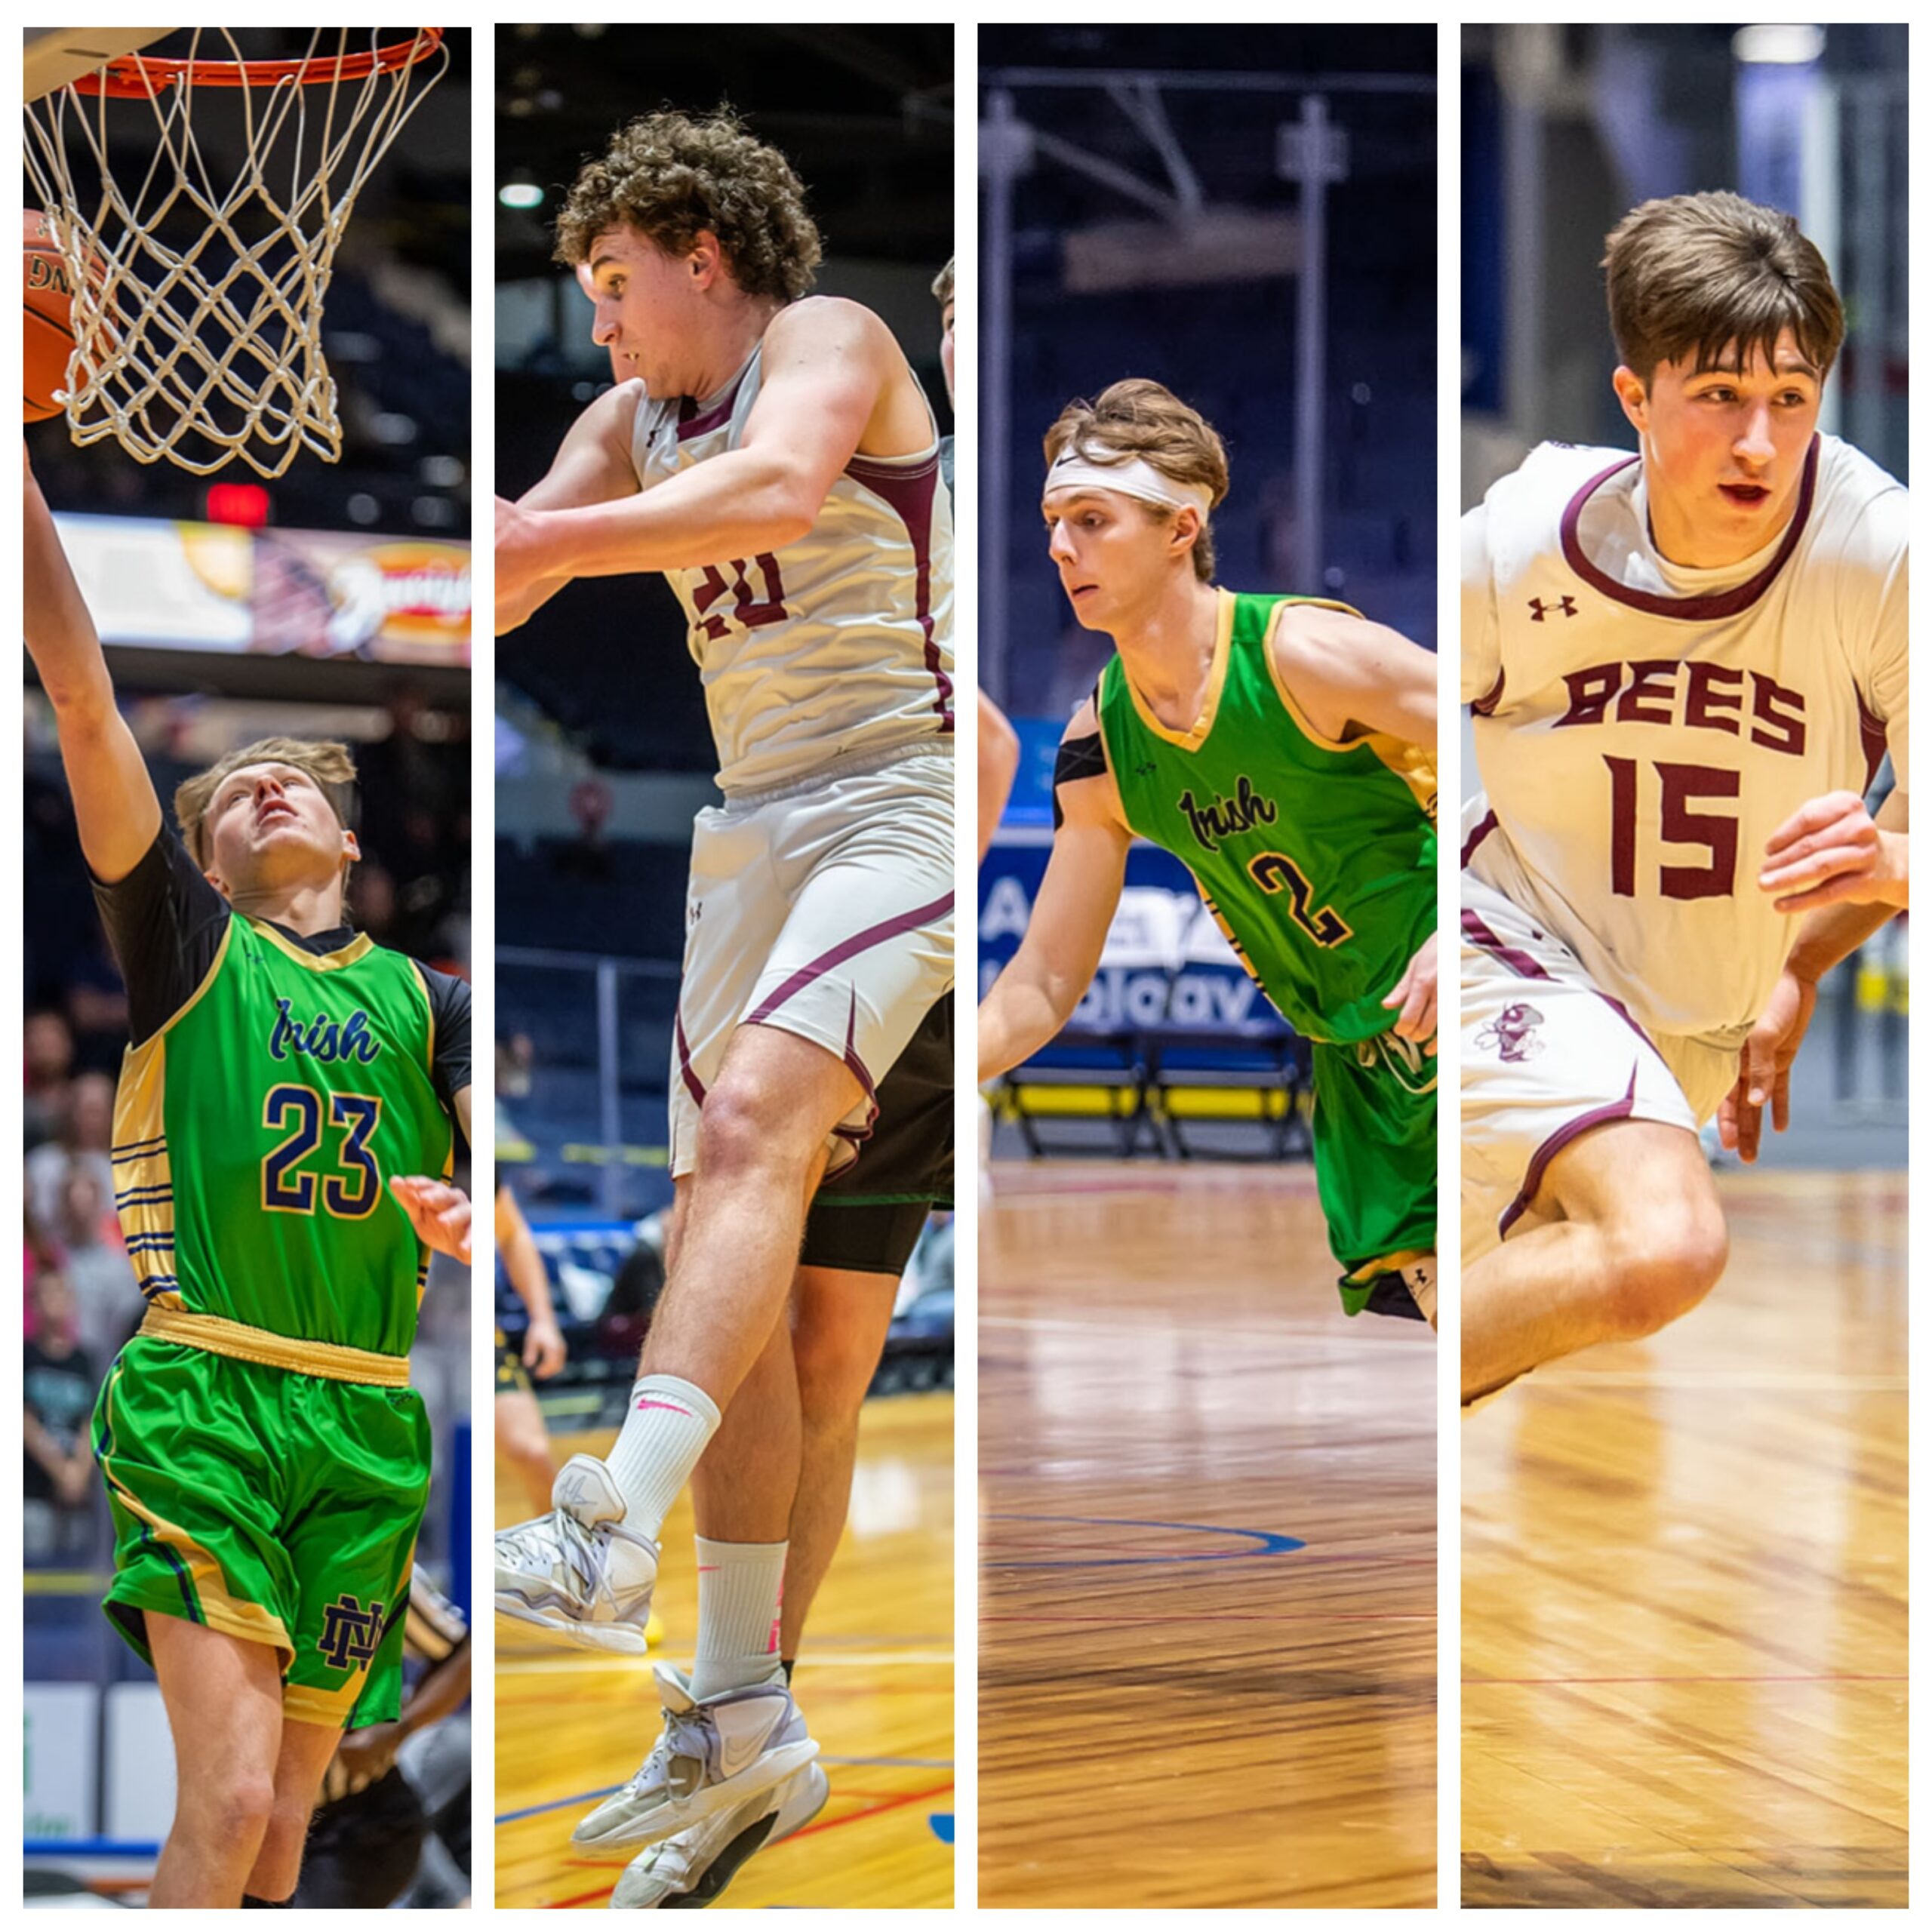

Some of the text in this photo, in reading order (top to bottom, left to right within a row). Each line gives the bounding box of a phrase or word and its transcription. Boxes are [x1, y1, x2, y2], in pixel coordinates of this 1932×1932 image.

[1550, 659, 1806, 756] BEES
[1178, 774, 1278, 852] Irish
[1601, 752, 1741, 900] 15
[1247, 851, 1354, 949] 2
[268, 997, 380, 1063] Irish
[260, 1082, 383, 1220] 23
